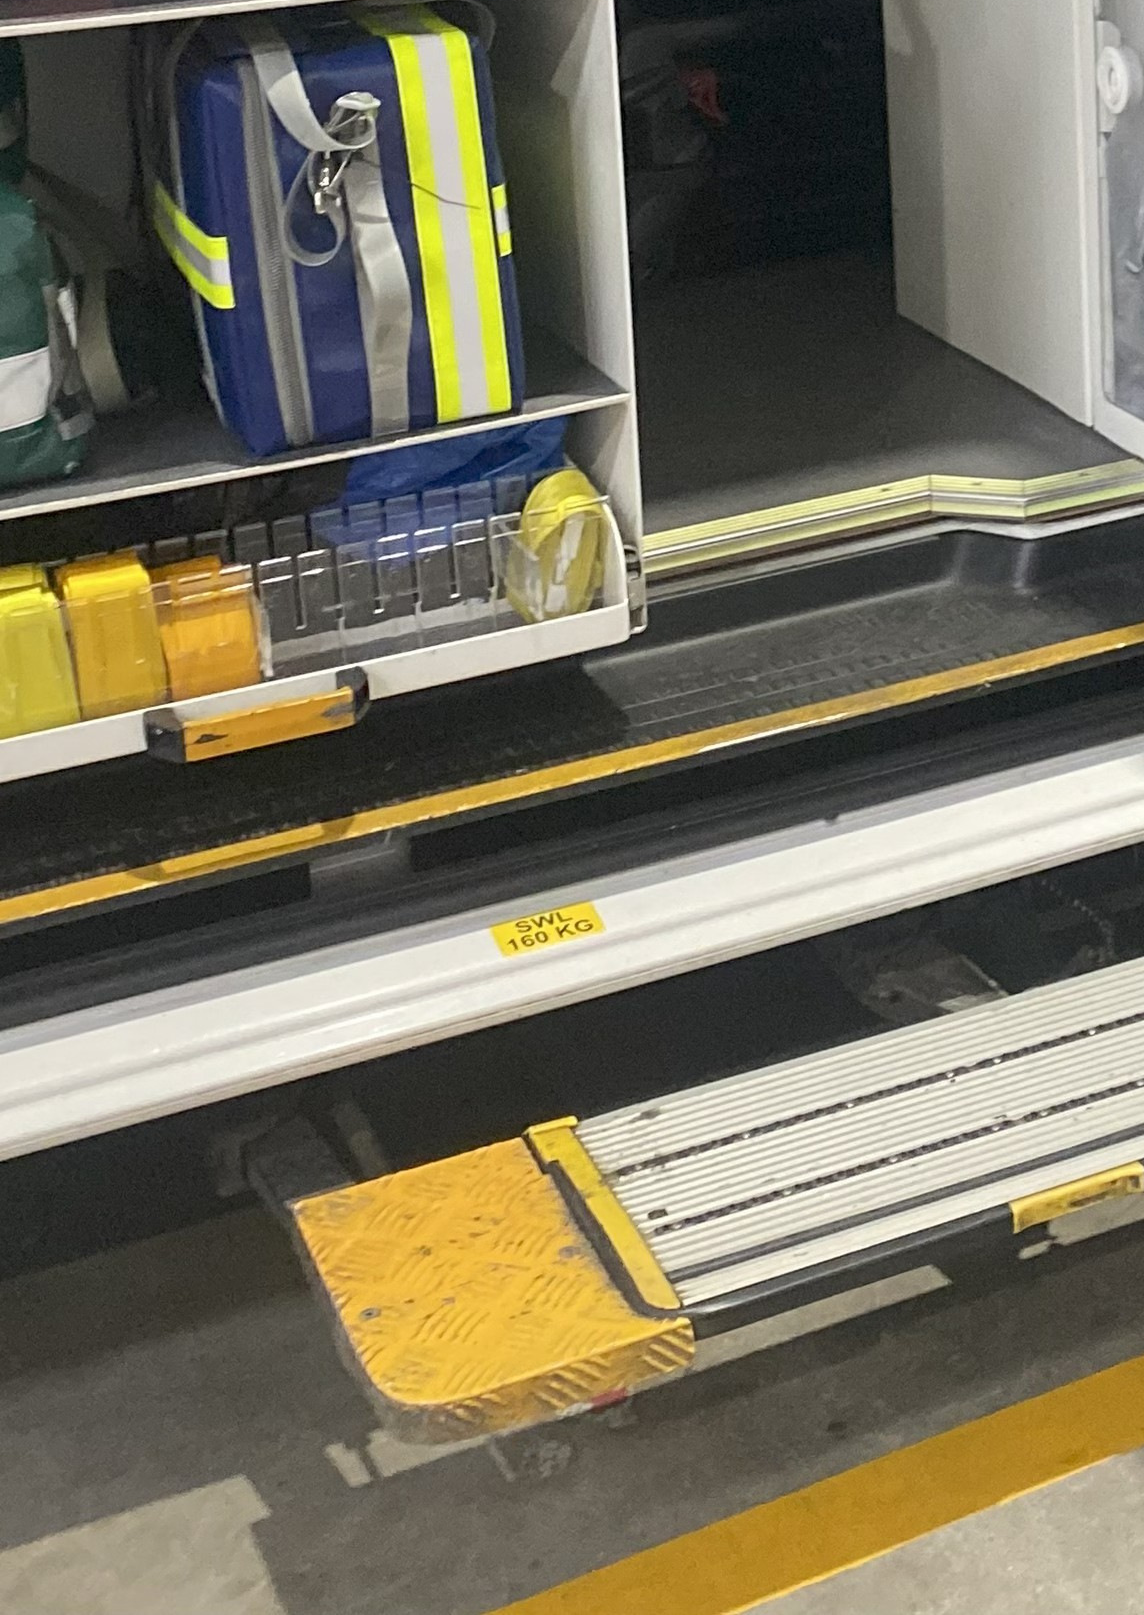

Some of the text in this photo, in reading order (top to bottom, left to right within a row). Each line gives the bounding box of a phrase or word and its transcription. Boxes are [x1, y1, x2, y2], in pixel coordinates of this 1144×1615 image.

[506, 918, 595, 952] 160 KG
[515, 911, 573, 933] SWL
